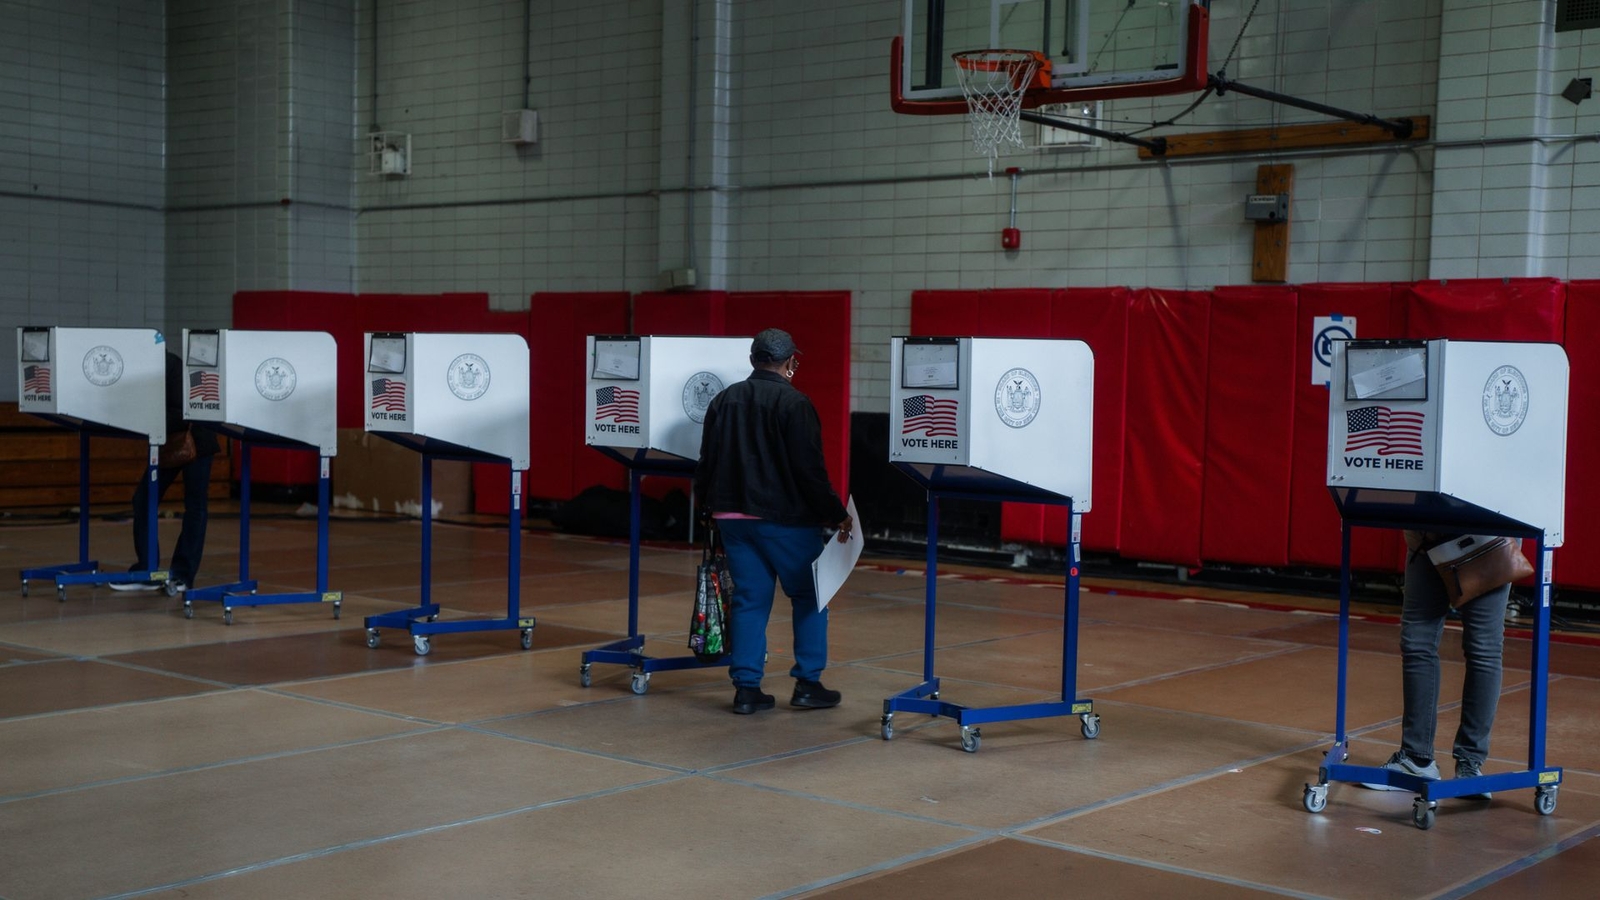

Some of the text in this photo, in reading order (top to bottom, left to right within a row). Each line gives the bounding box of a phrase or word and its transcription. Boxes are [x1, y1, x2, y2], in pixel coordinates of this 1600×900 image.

[24, 394, 52, 402] VOTE HERE
[188, 402, 221, 411] VOTE HERE
[389, 412, 407, 422] HERE
[594, 424, 641, 434] VOTE HERE
[902, 438, 958, 449] VOTE HERE
[1344, 456, 1423, 470] VOTE HERE
